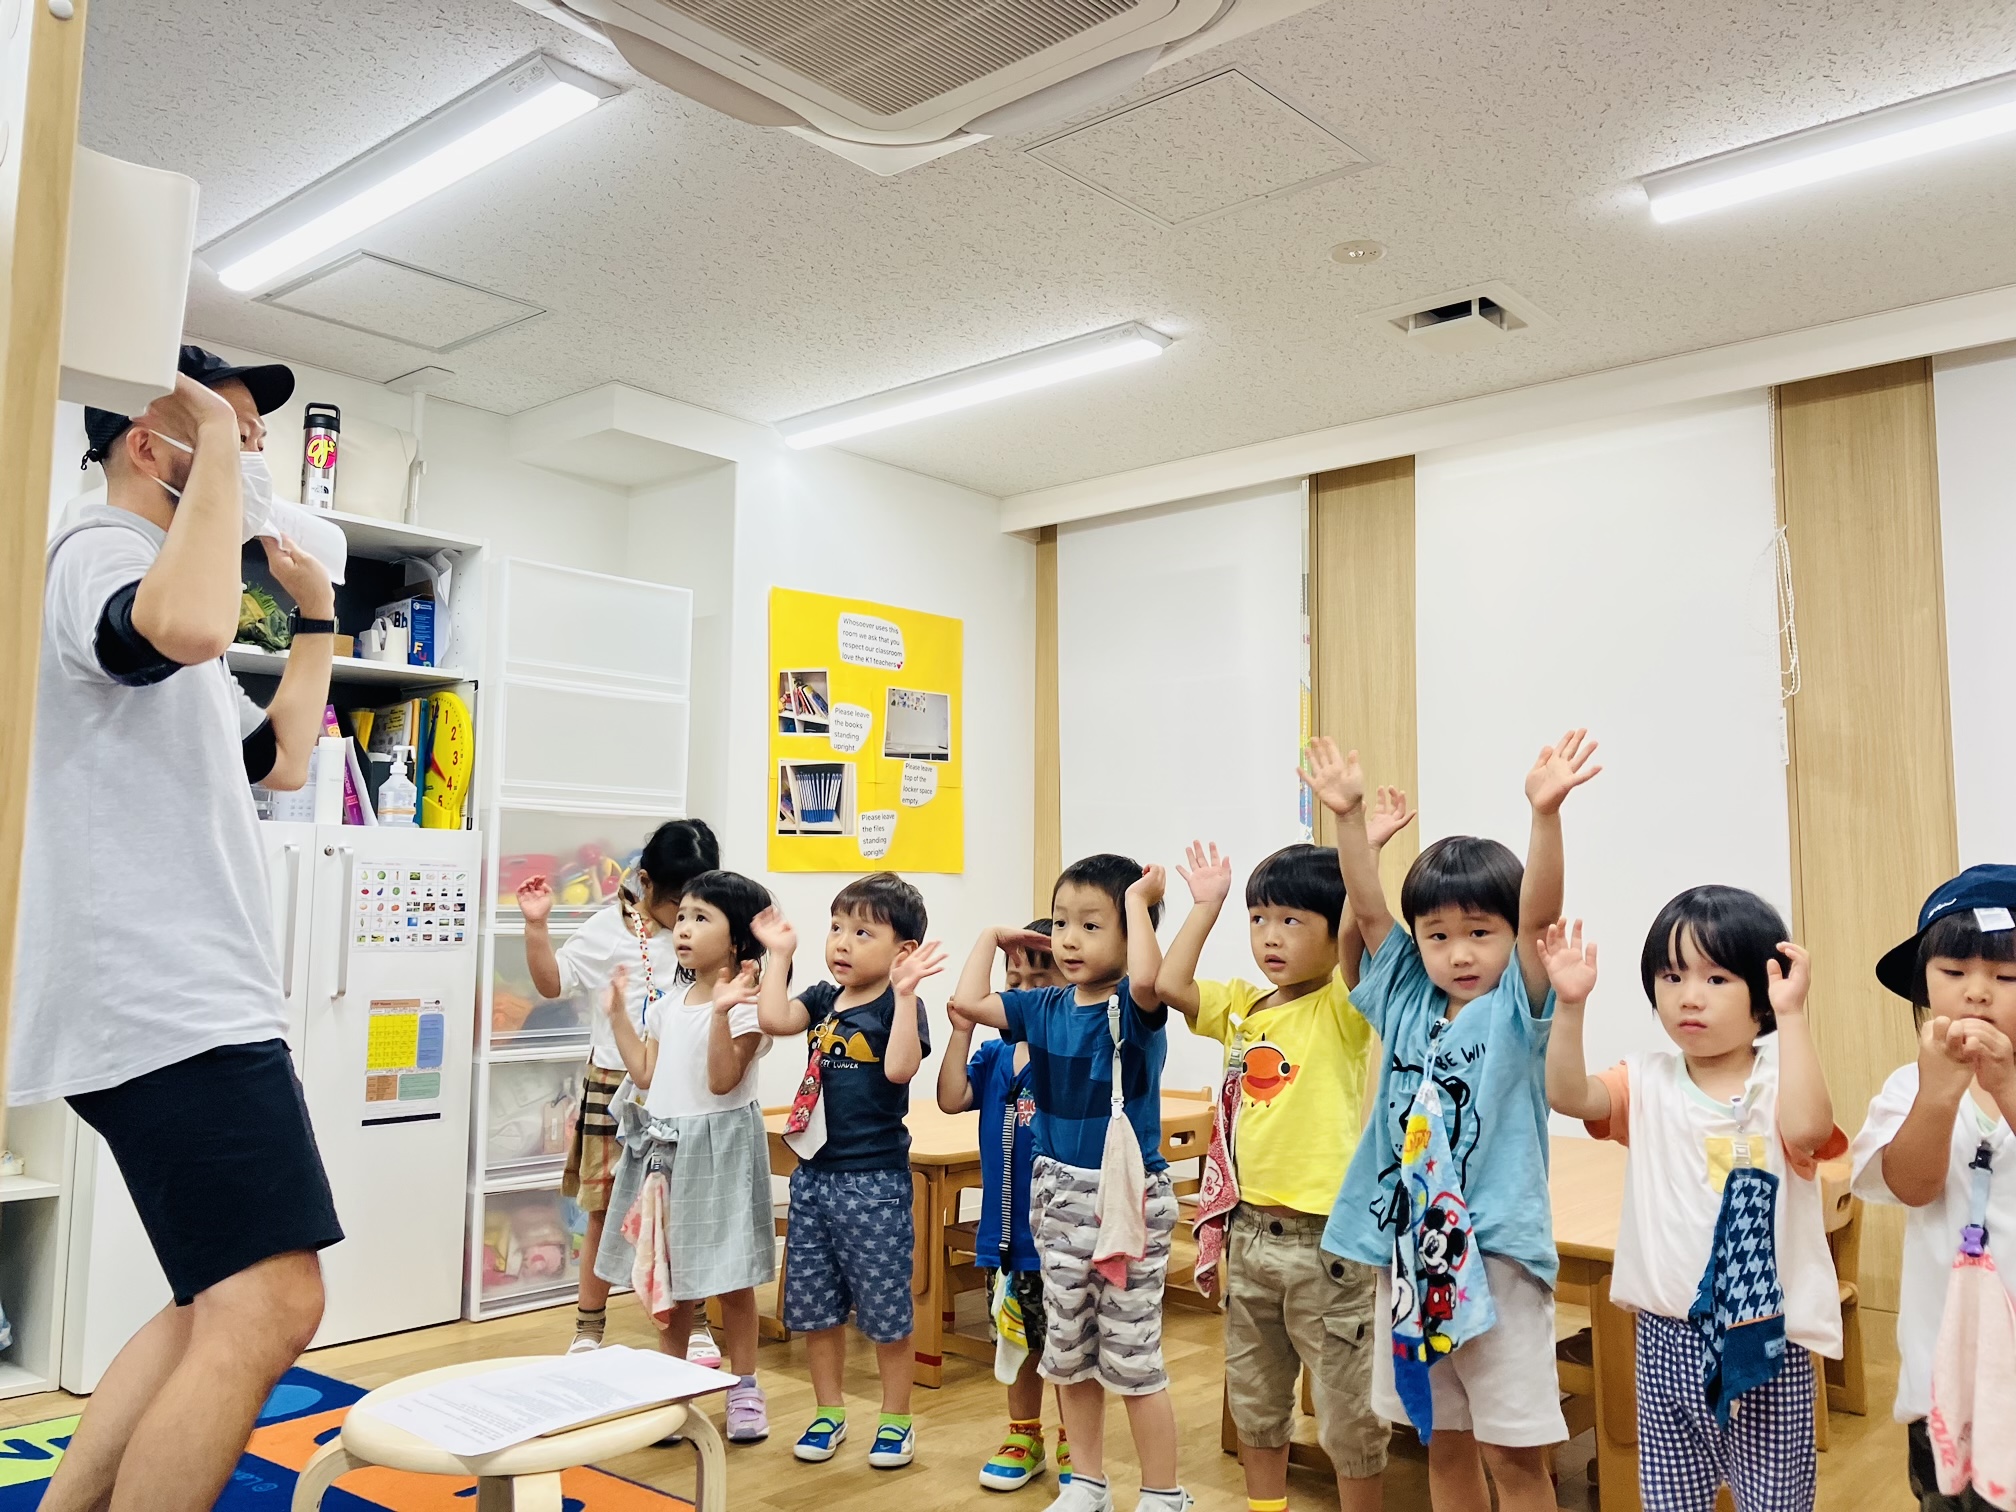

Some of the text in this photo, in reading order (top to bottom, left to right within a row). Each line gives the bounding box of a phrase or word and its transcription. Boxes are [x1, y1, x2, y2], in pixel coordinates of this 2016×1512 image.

[843, 617, 899, 635] Whosoever uses this
[842, 630, 858, 638] room
[868, 634, 878, 642] ask
[879, 636, 890, 644] that
[842, 642, 865, 651] respect
[875, 647, 903, 658] classroom
[842, 652, 854, 661] love
[855, 655, 865, 663] the
[873, 658, 897, 668] teachers
[834, 707, 870, 719] Please leave
[834, 719, 863, 729] the books
[450, 726, 457, 741] 2
[834, 731, 860, 742] standing
[452, 750, 459, 766] 3
[905, 762, 933, 773] Please leave
[446, 776, 453, 791] 4
[904, 774, 913, 782] top
[919, 775, 927, 783] the
[902, 785, 933, 795] locker space
[438, 794, 443, 807] 5
[862, 824, 885, 833] the files
[862, 836, 887, 845] standing
